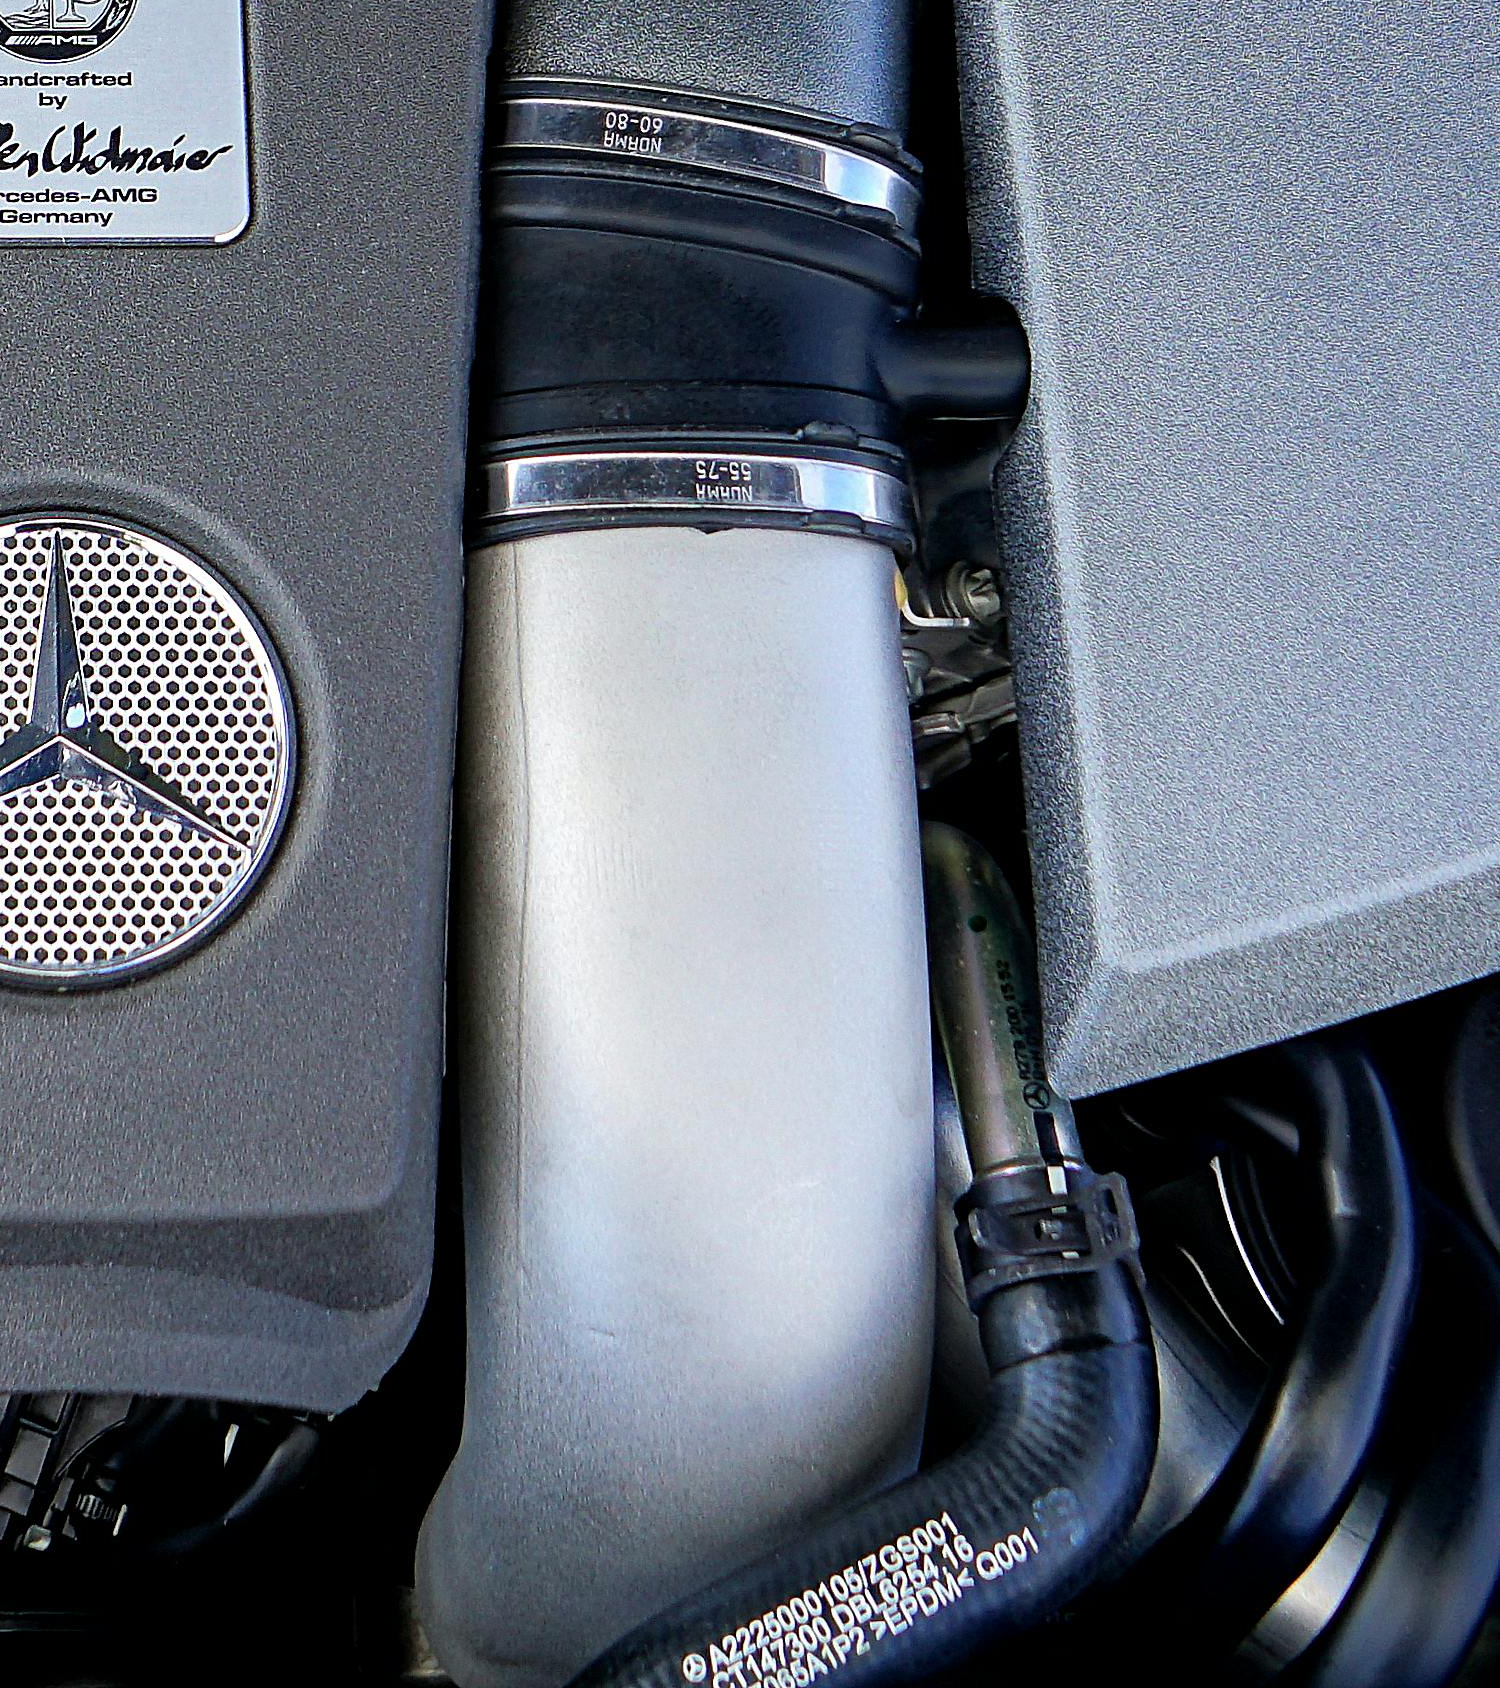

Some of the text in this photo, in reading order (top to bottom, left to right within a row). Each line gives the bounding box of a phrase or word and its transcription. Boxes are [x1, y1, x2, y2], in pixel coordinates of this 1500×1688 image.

[38, 92, 68, 110] by
[604, 110, 664, 134] 60-80
[603, 130, 662, 153] NORMA
[695, 459, 752, 482] 55-75
[975, 1526, 1041, 1582] Q001
